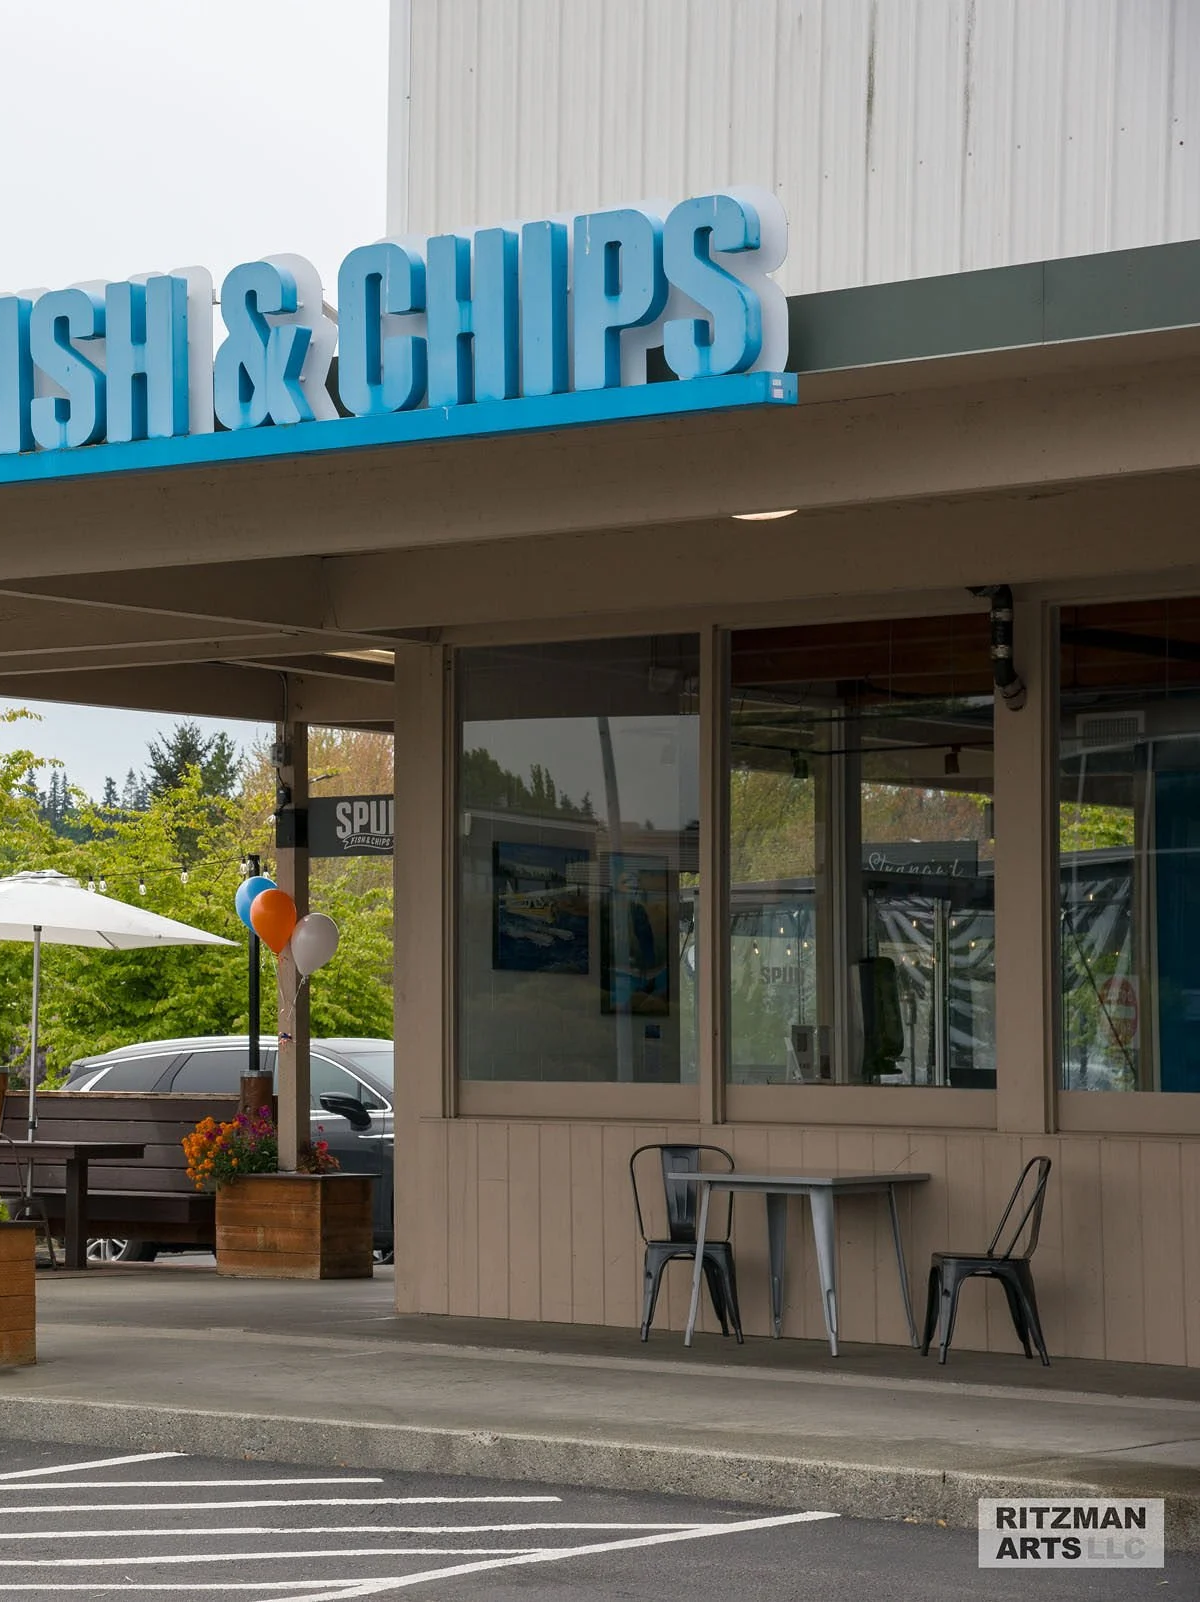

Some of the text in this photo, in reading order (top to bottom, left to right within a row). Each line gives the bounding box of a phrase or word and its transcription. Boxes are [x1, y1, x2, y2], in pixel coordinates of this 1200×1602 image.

[215, 261, 316, 430] &
[338, 195, 762, 416] CHIPS
[350, 836, 365, 845] FISH
[371, 837, 391, 846] CHIPS
